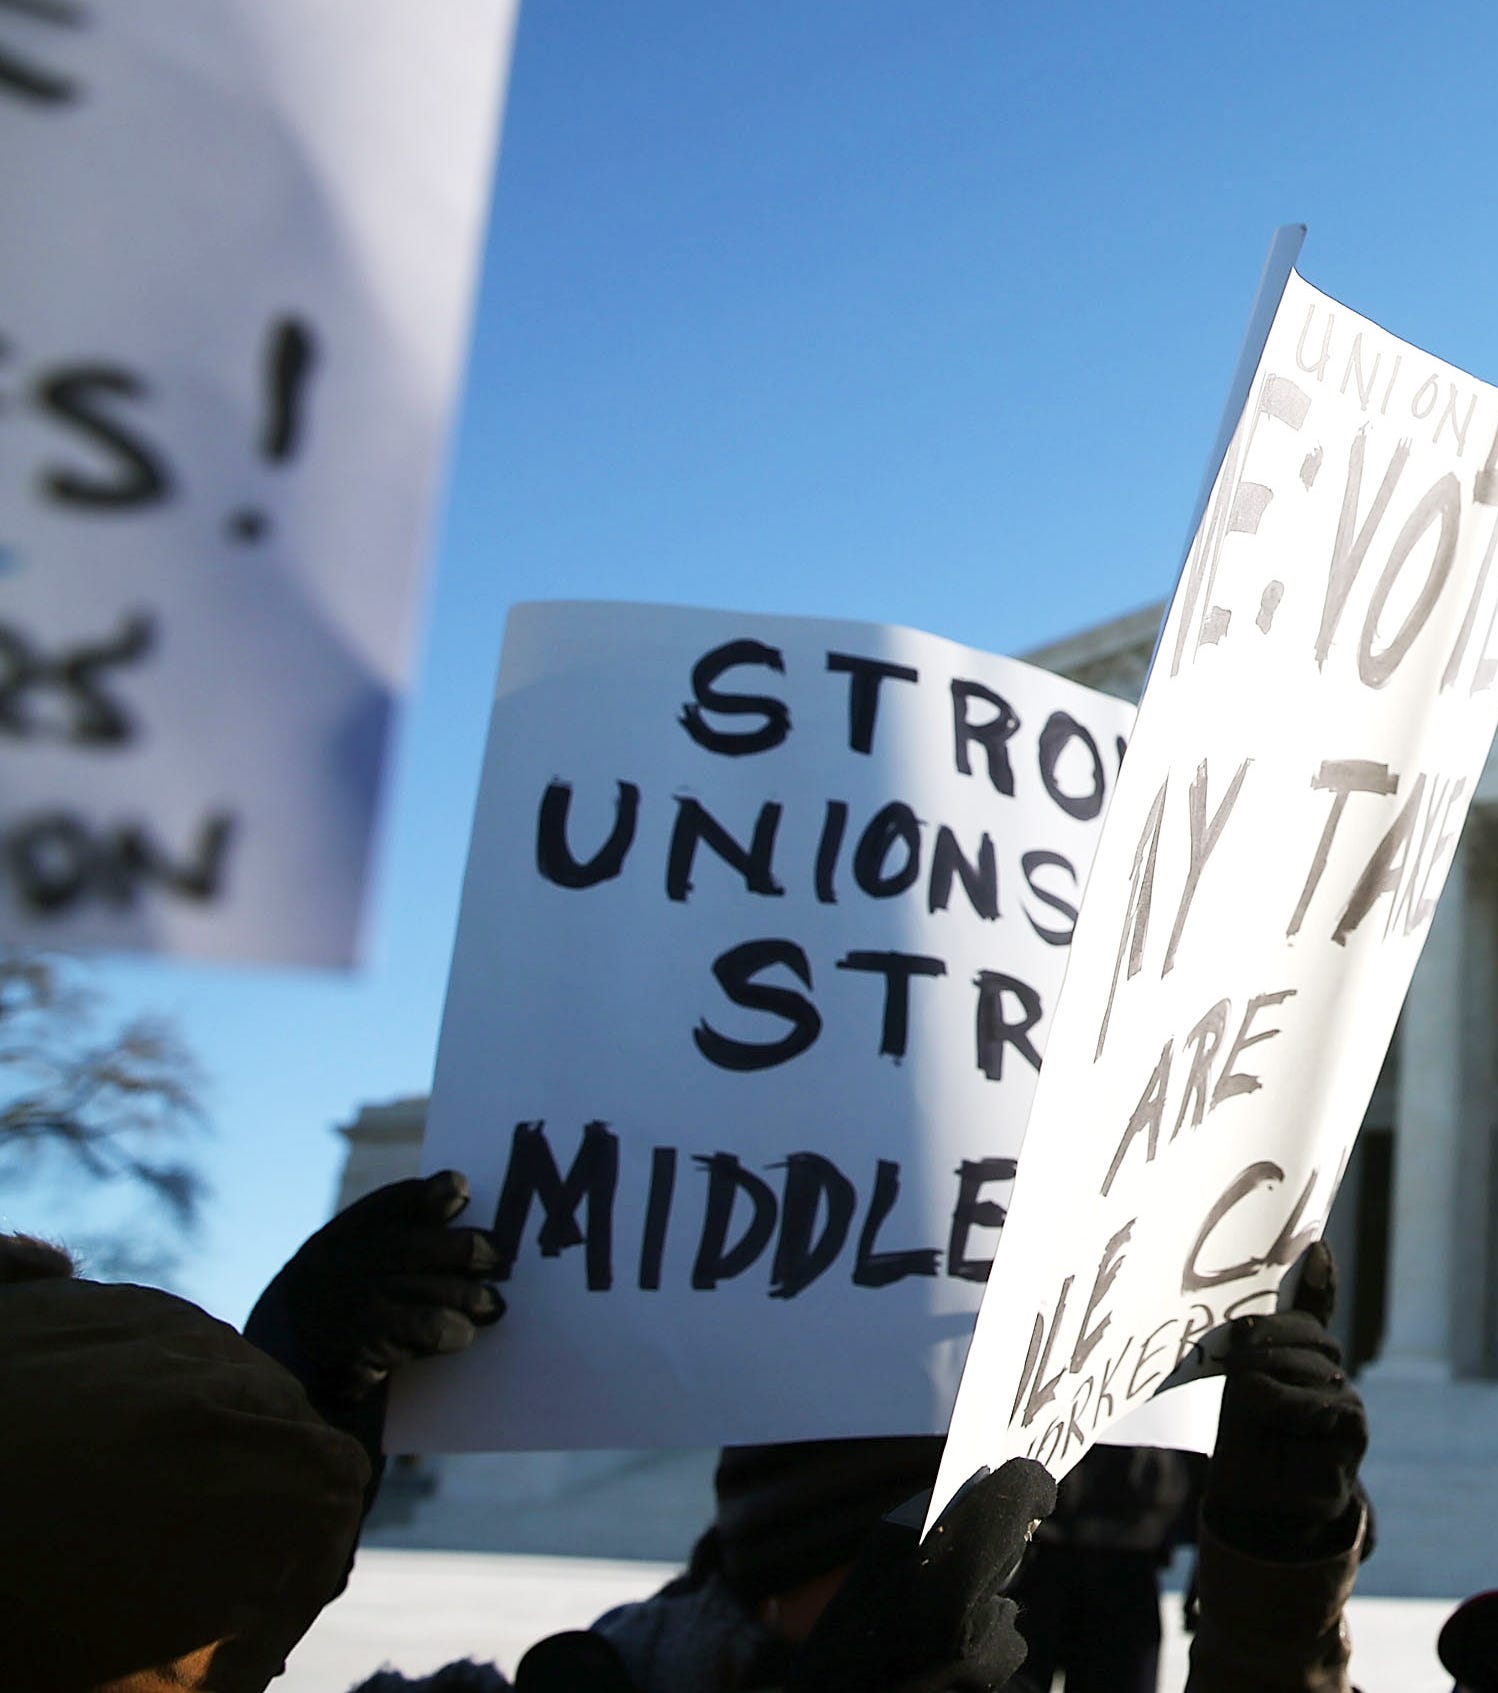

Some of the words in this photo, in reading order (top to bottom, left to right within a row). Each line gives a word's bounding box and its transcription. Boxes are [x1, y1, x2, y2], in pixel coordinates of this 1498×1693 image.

[677, 639, 1129, 821] STRO
[536, 776, 1080, 946] UNIONS
[1101, 988, 1298, 1198] ARE
[491, 1119, 1018, 1299] MIDDLE
